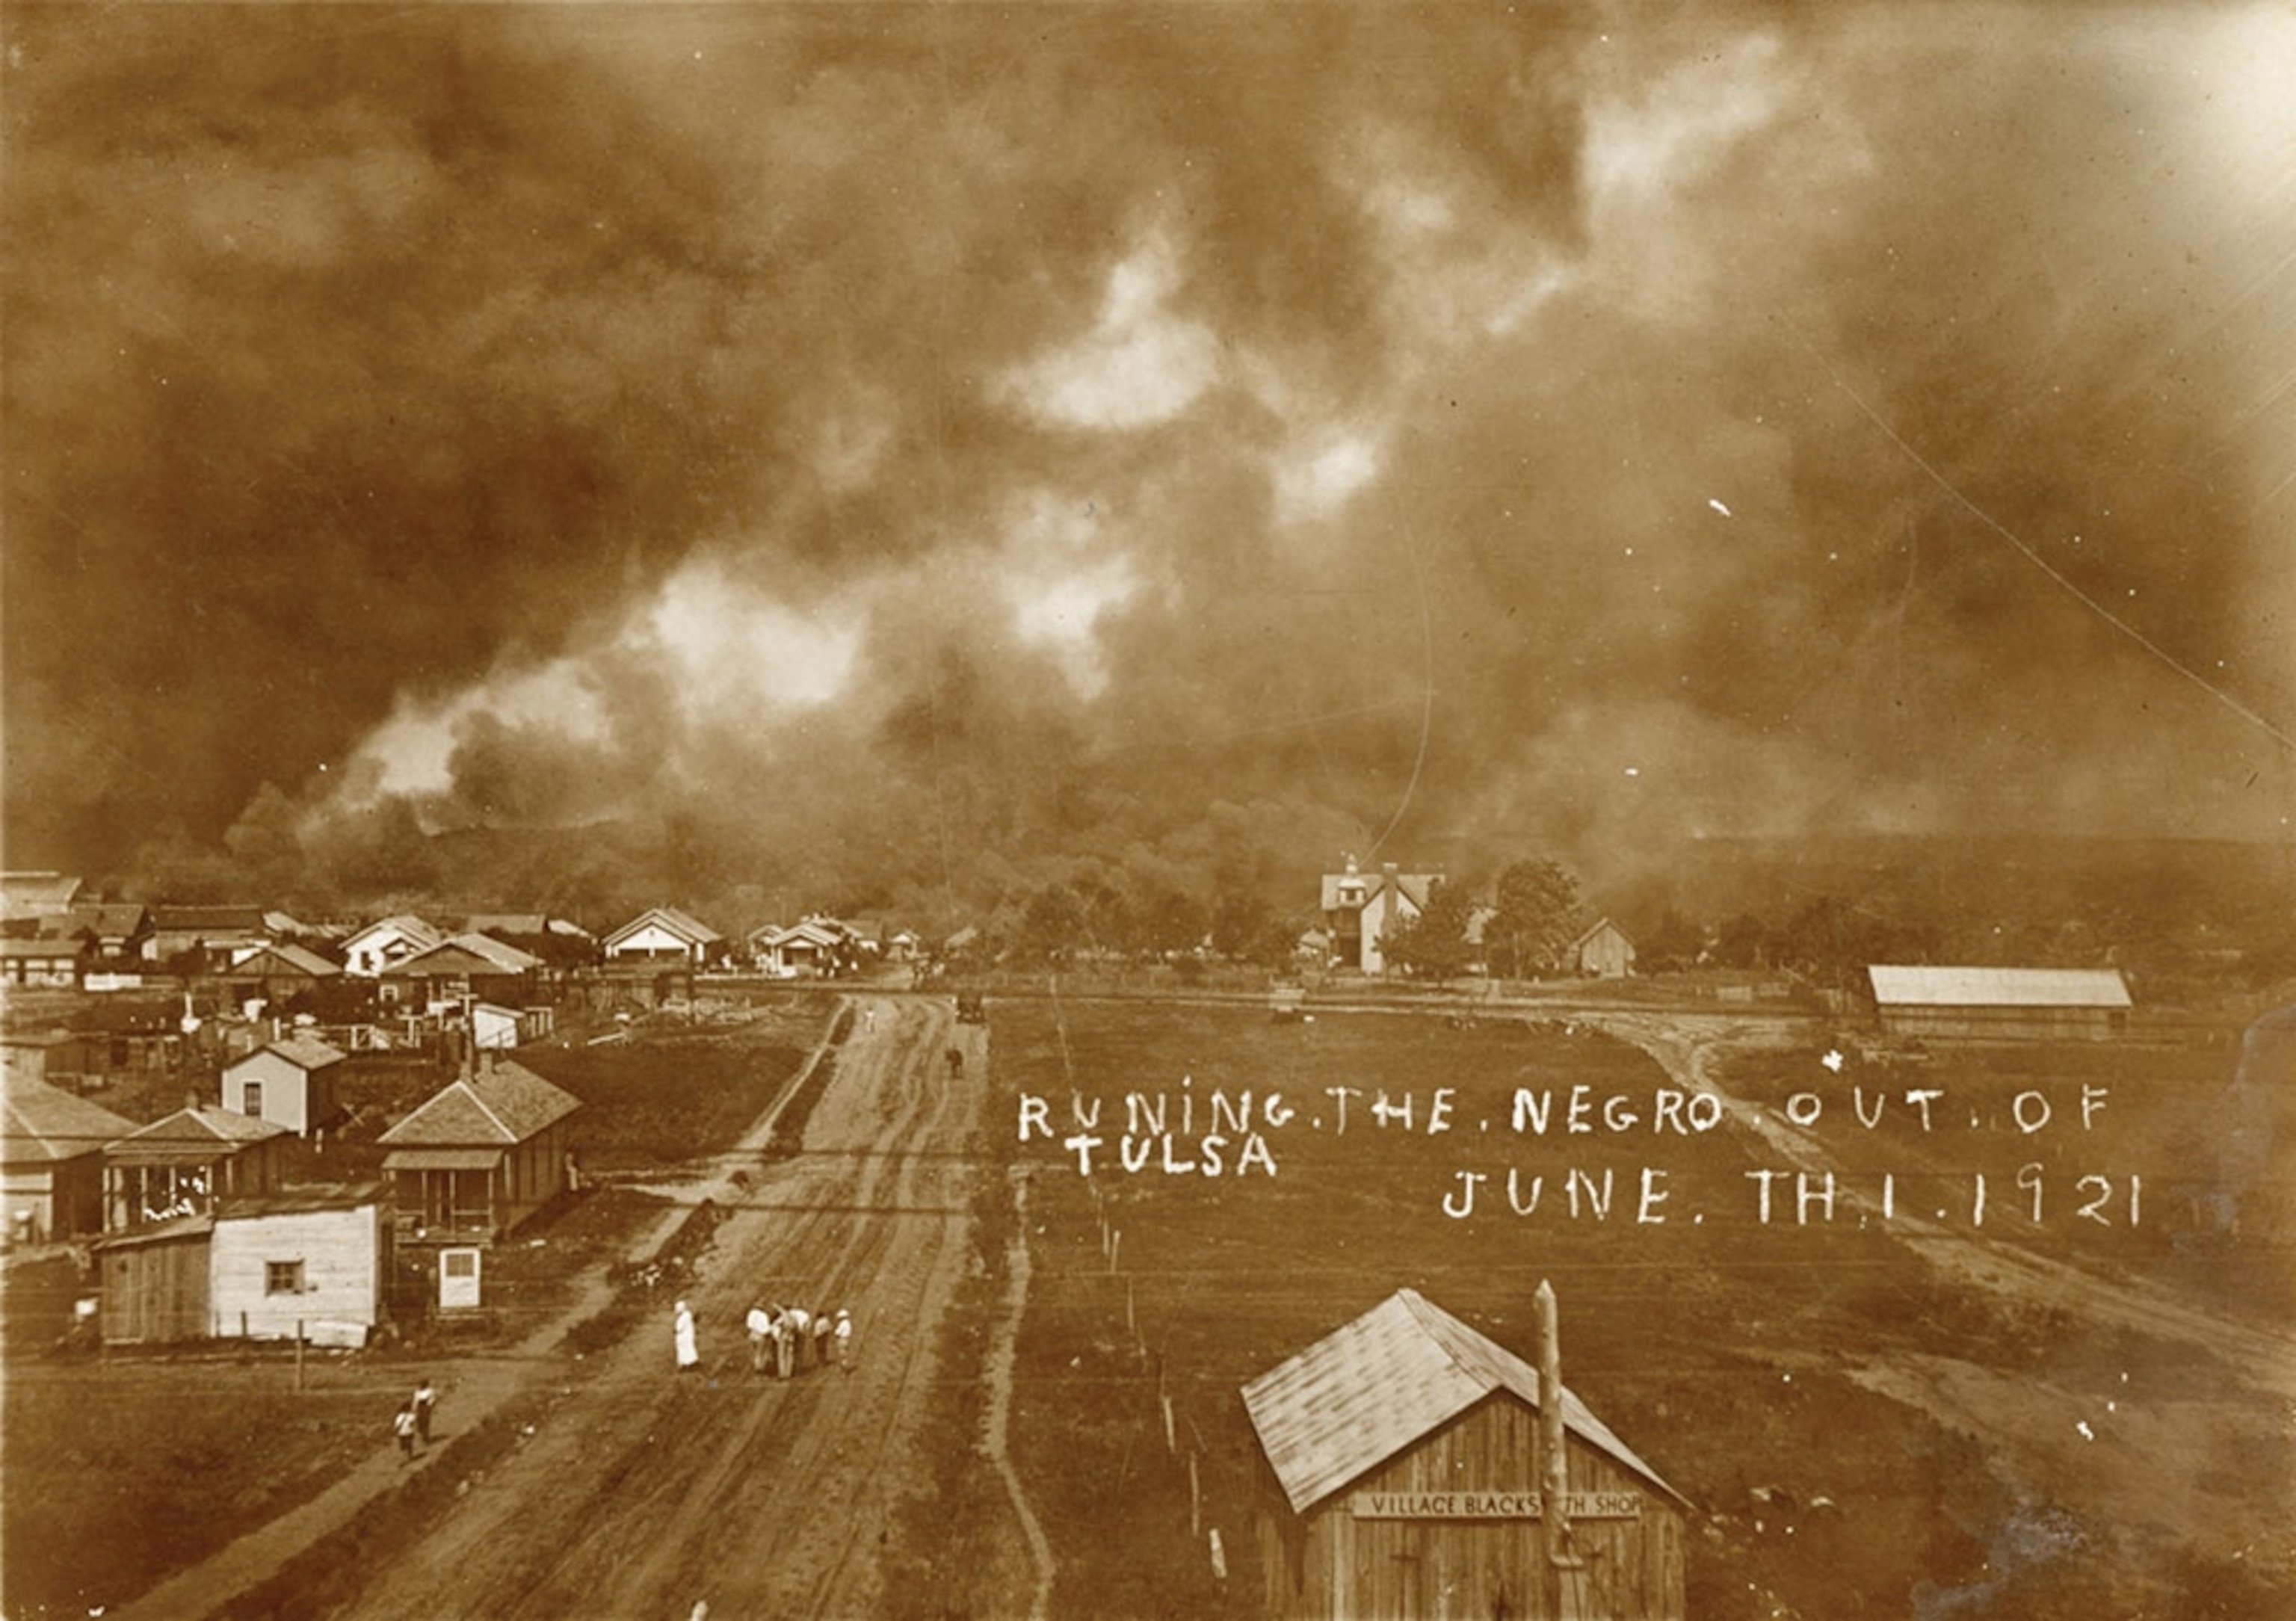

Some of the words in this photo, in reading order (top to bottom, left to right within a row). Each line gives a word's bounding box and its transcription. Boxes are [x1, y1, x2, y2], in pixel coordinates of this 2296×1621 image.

[1371, 1495, 1456, 1515] VILLAGE
[1465, 1495, 1585, 1515] BLACKSTH
[1595, 1495, 1641, 1515] SHOP
